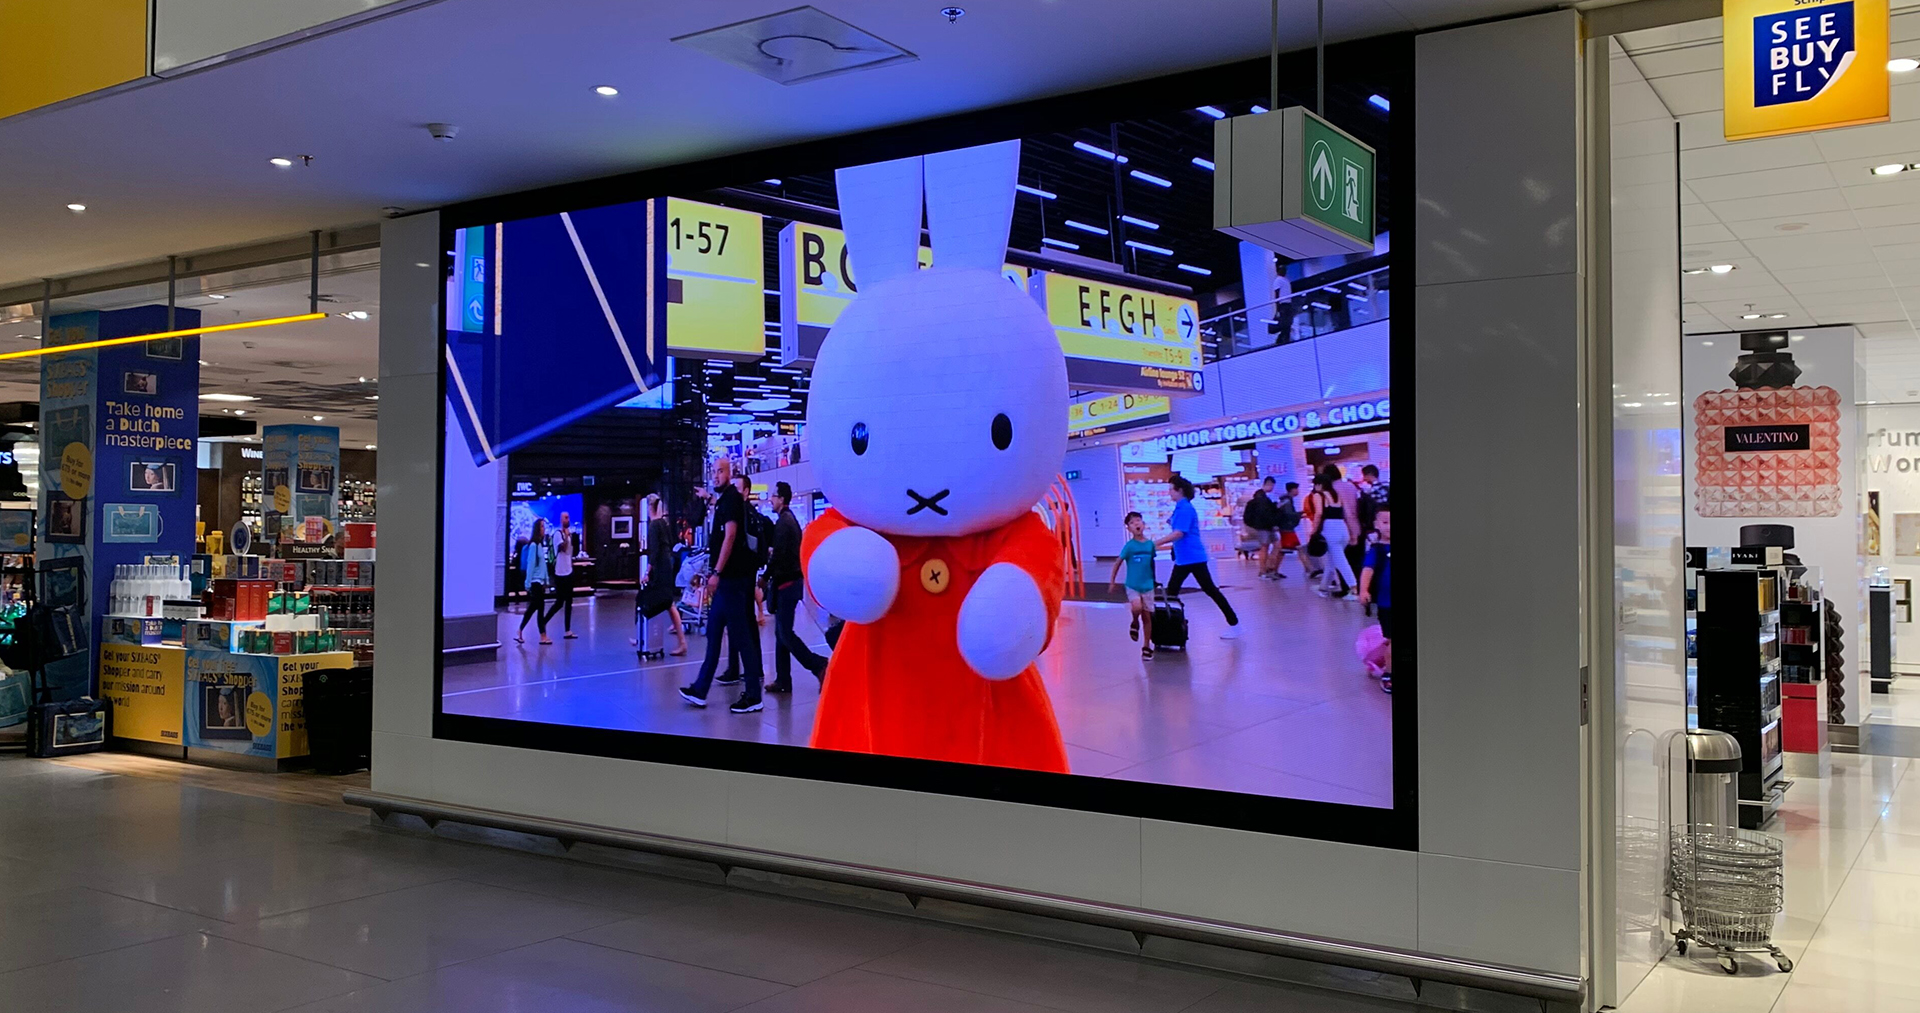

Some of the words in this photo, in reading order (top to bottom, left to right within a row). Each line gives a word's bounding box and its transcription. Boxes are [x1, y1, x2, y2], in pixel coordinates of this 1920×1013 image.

[1771, 13, 1836, 44] SEE
[1770, 37, 1841, 71] BUY
[669, 217, 729, 257] 1-57
[106, 401, 140, 417] Take
[145, 403, 184, 419] home
[1123, 394, 1134, 410] D
[105, 418, 115, 431] a
[120, 418, 160, 433] Dutch
[1214, 415, 1299, 442] TOBACCO
[1306, 411, 1321, 428] &
[105, 433, 192, 451] masterpiece
[1735, 431, 1799, 444] VALENTINO
[292, 545, 320, 554] HEALTHY
[103, 649, 114, 661] Get
[116, 652, 130, 664] your
[103, 664, 130, 678] Shopper
[132, 667, 145, 679] and
[145, 668, 162, 682] carry
[282, 662, 297, 672] Get
[300, 662, 319, 672] your
[102, 680, 113, 691] our
[115, 681, 140, 693] mission
[141, 684, 165, 696] around
[223, 673, 258, 688] Shopper
